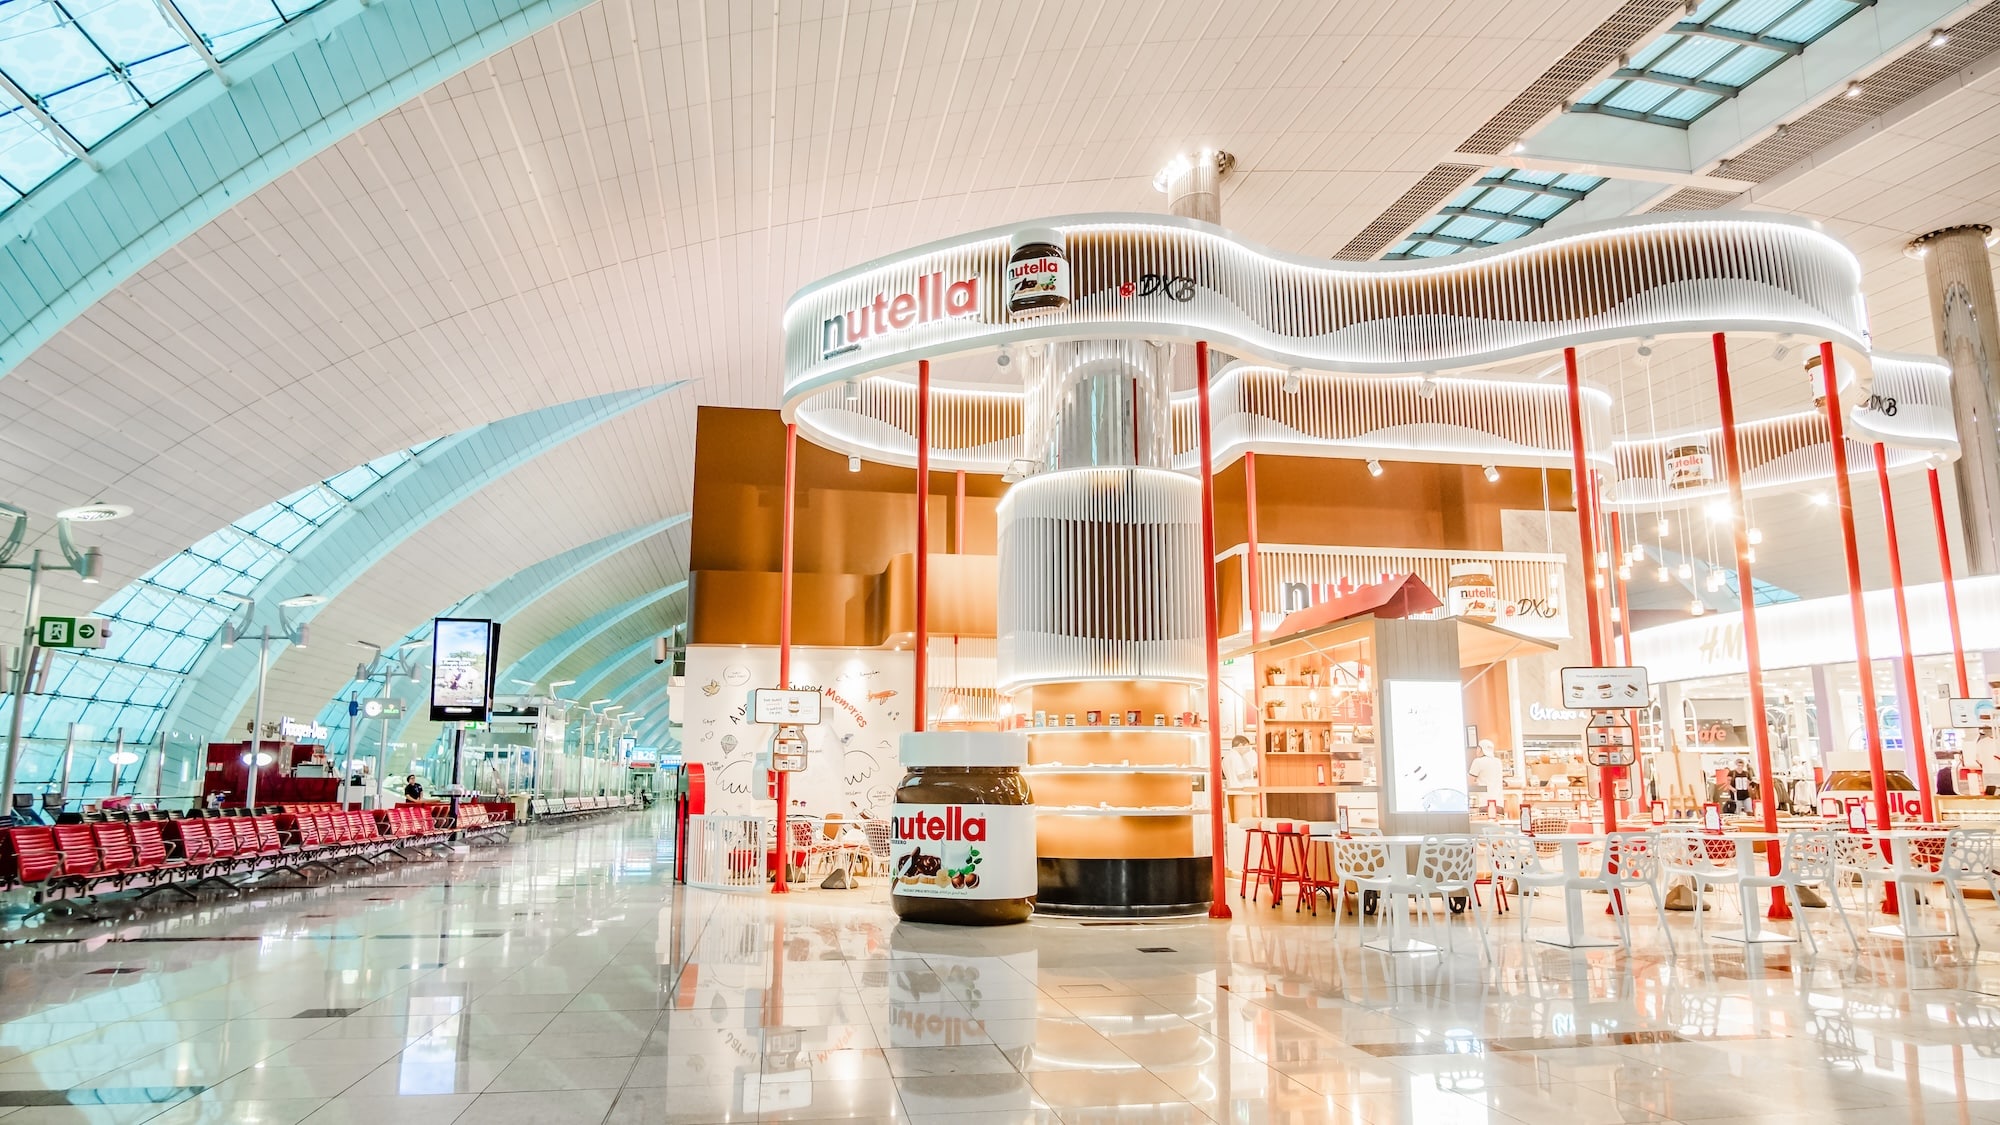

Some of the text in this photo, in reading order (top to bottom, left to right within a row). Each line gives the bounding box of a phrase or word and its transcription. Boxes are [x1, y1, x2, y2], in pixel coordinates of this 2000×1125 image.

[1008, 258, 1058, 280] nutella
[1138, 273, 1195, 302] DXB
[823, 271, 979, 353] nutella
[1460, 587, 1496, 598] nutella
[1699, 622, 1743, 664] HM
[825, 687, 867, 728] Memories
[891, 806, 986, 842] nutella
